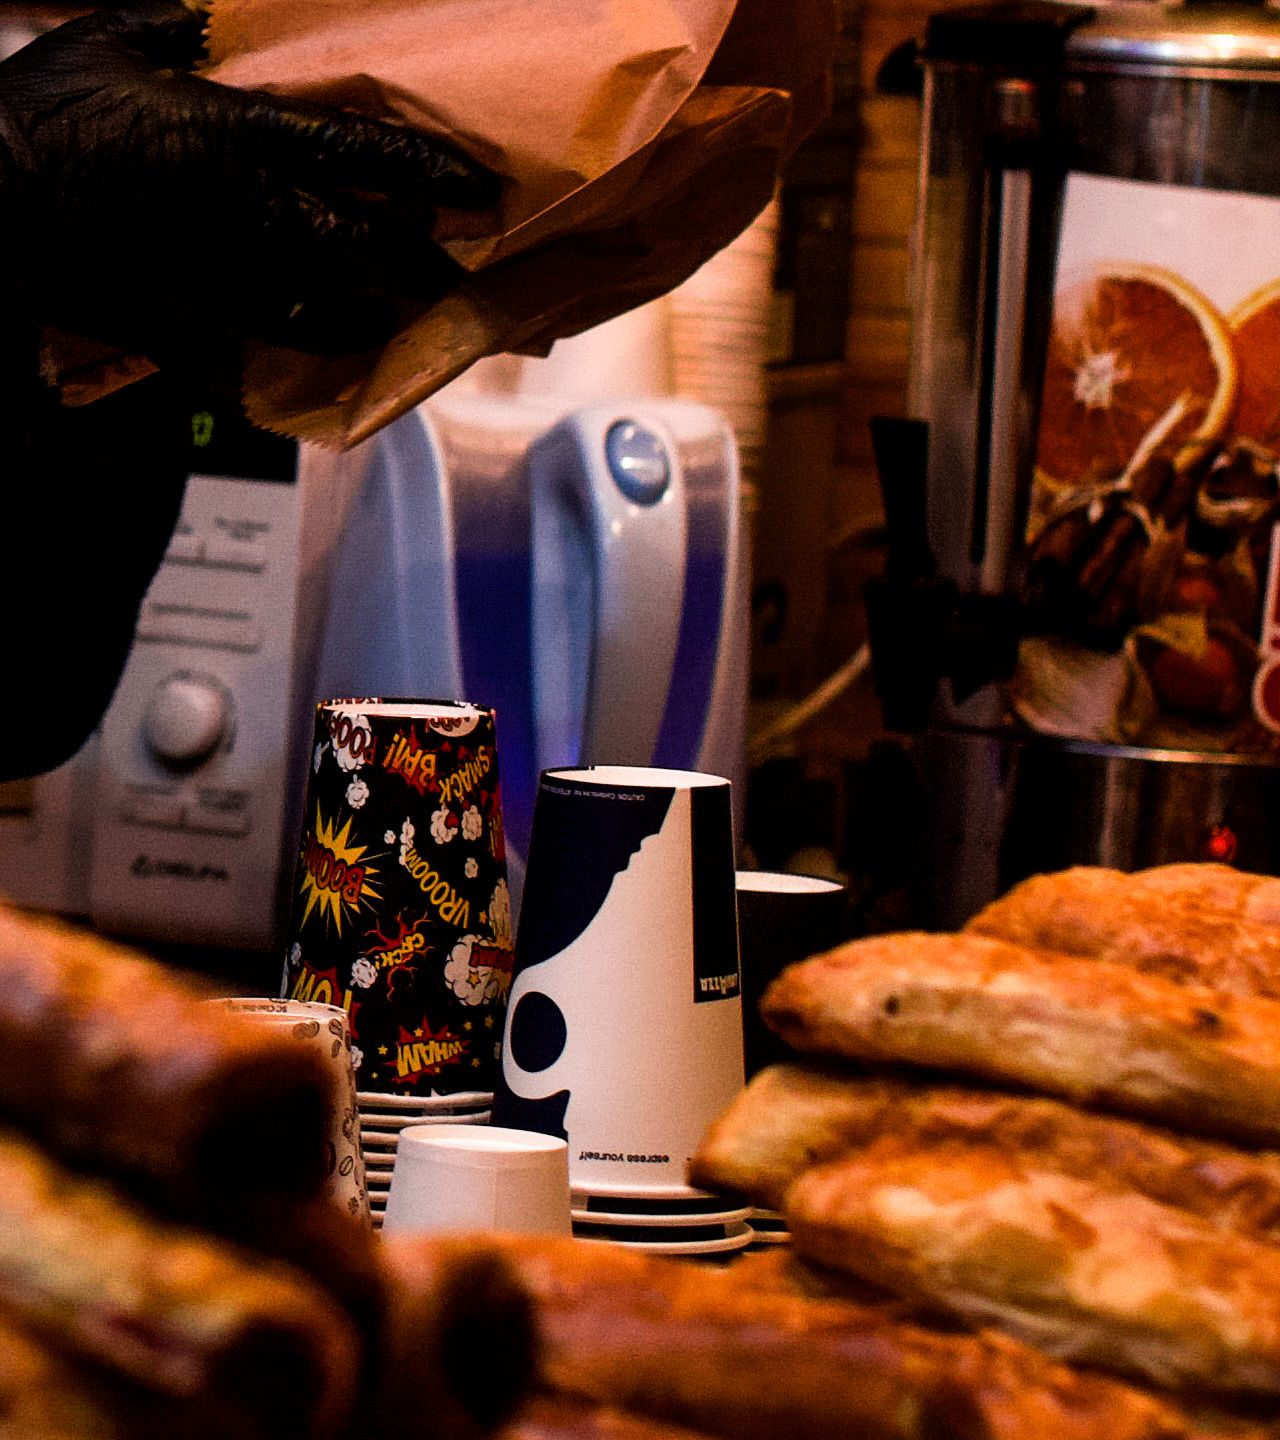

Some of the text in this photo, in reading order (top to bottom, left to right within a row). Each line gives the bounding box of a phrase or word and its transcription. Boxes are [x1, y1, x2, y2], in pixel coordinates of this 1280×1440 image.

[437, 745, 492, 804] SMACK
[405, 848, 471, 929] VROOOM
[396, 1039, 464, 1077] WHAM
[579, 1151, 624, 1162] yourself
